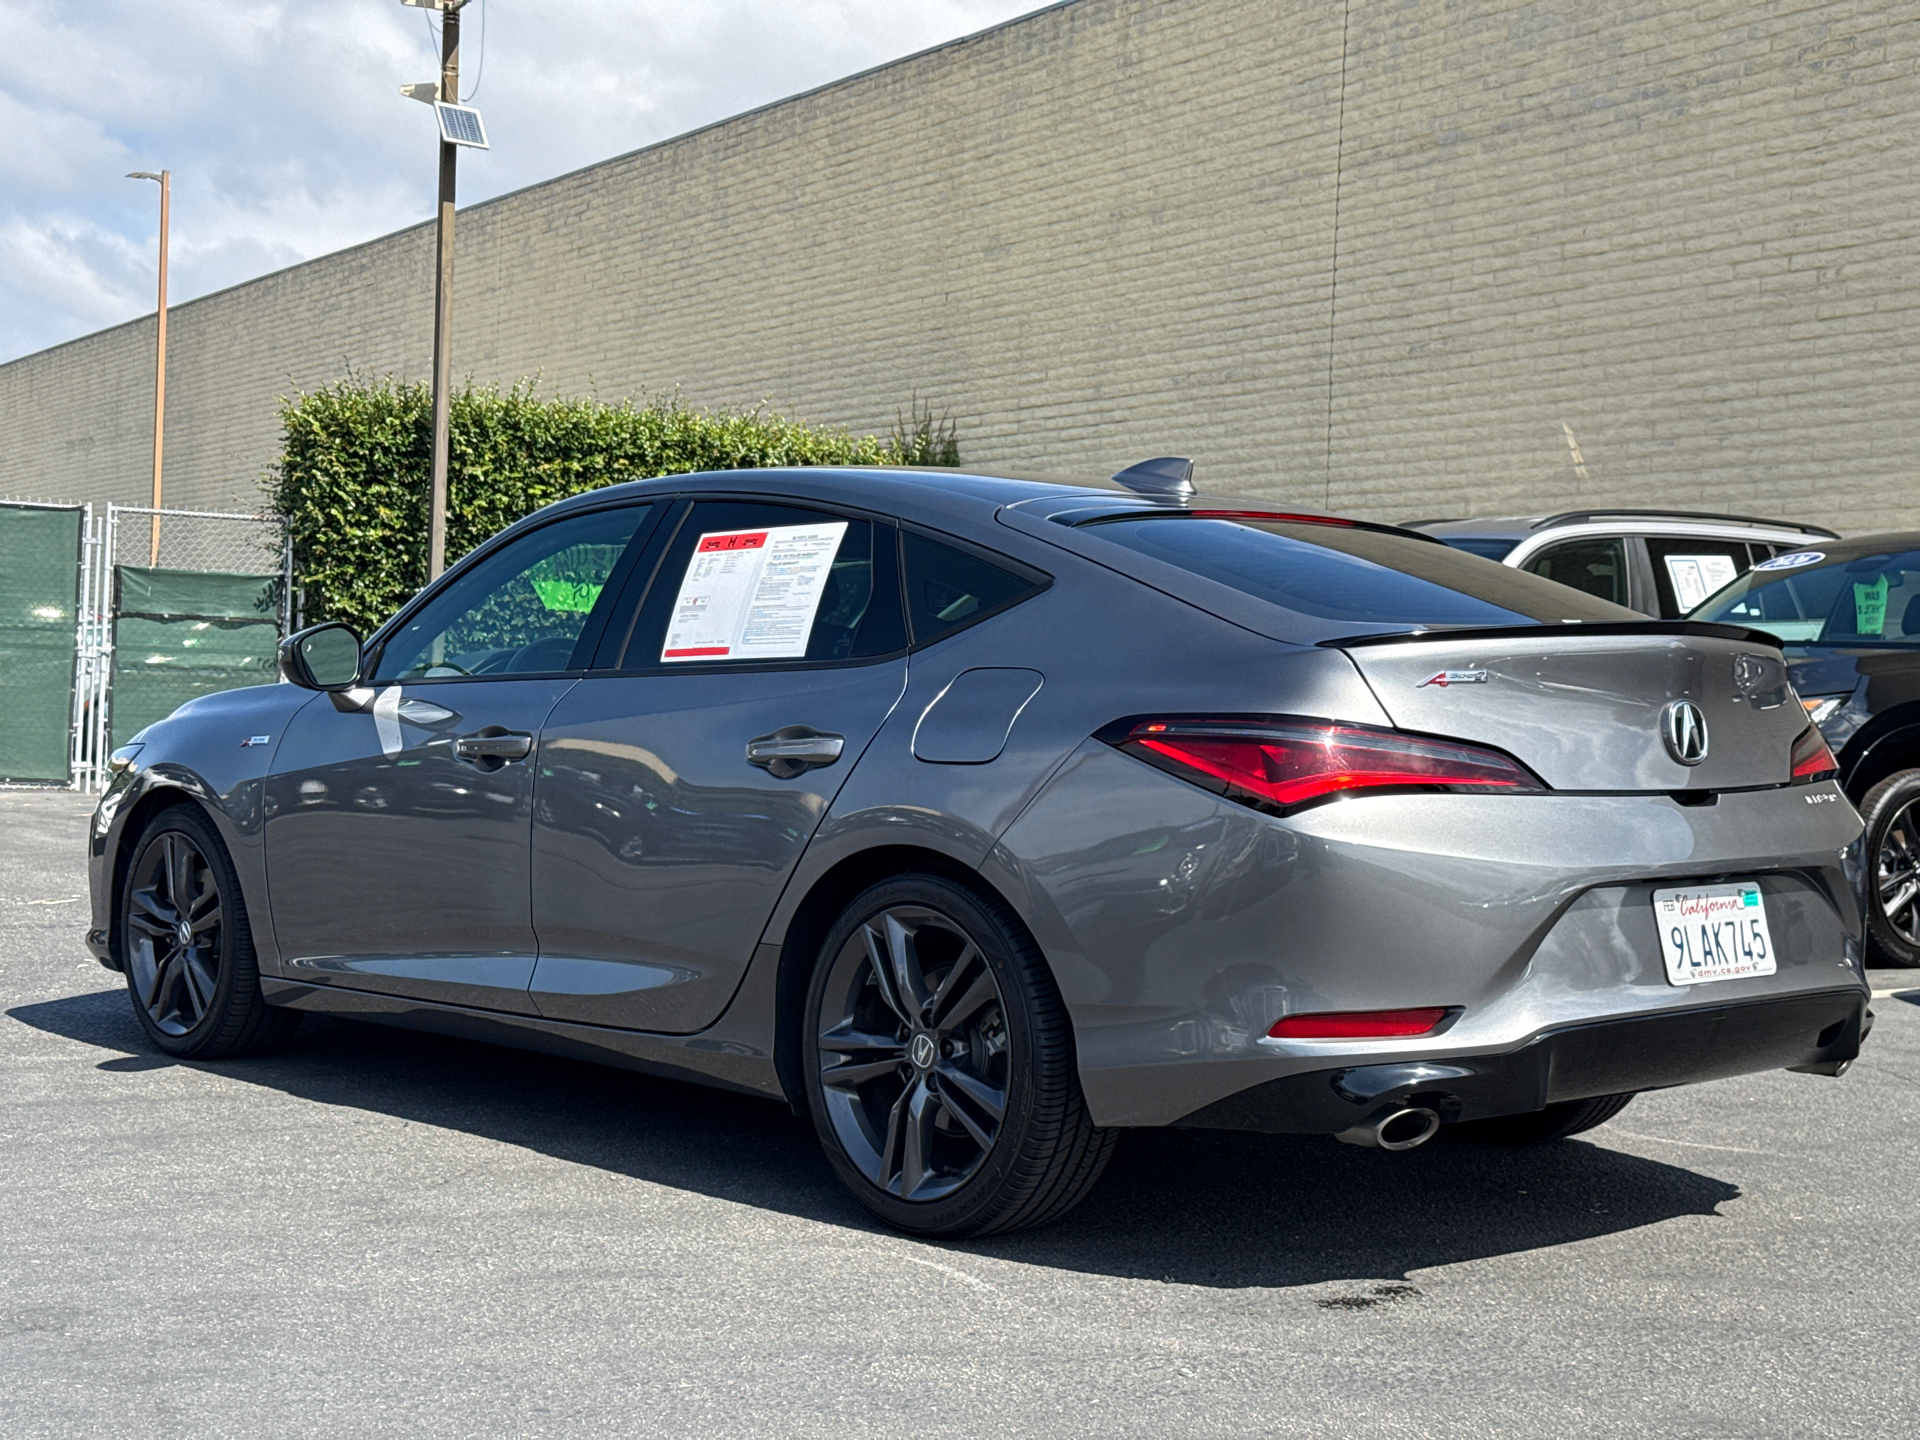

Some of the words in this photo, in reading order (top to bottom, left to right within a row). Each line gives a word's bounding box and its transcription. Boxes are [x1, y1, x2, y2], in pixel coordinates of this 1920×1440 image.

[1679, 893, 1745, 920] California
[1670, 918, 1767, 970] 9LAK745
[1697, 964, 1751, 978] dmv.ca.gov
